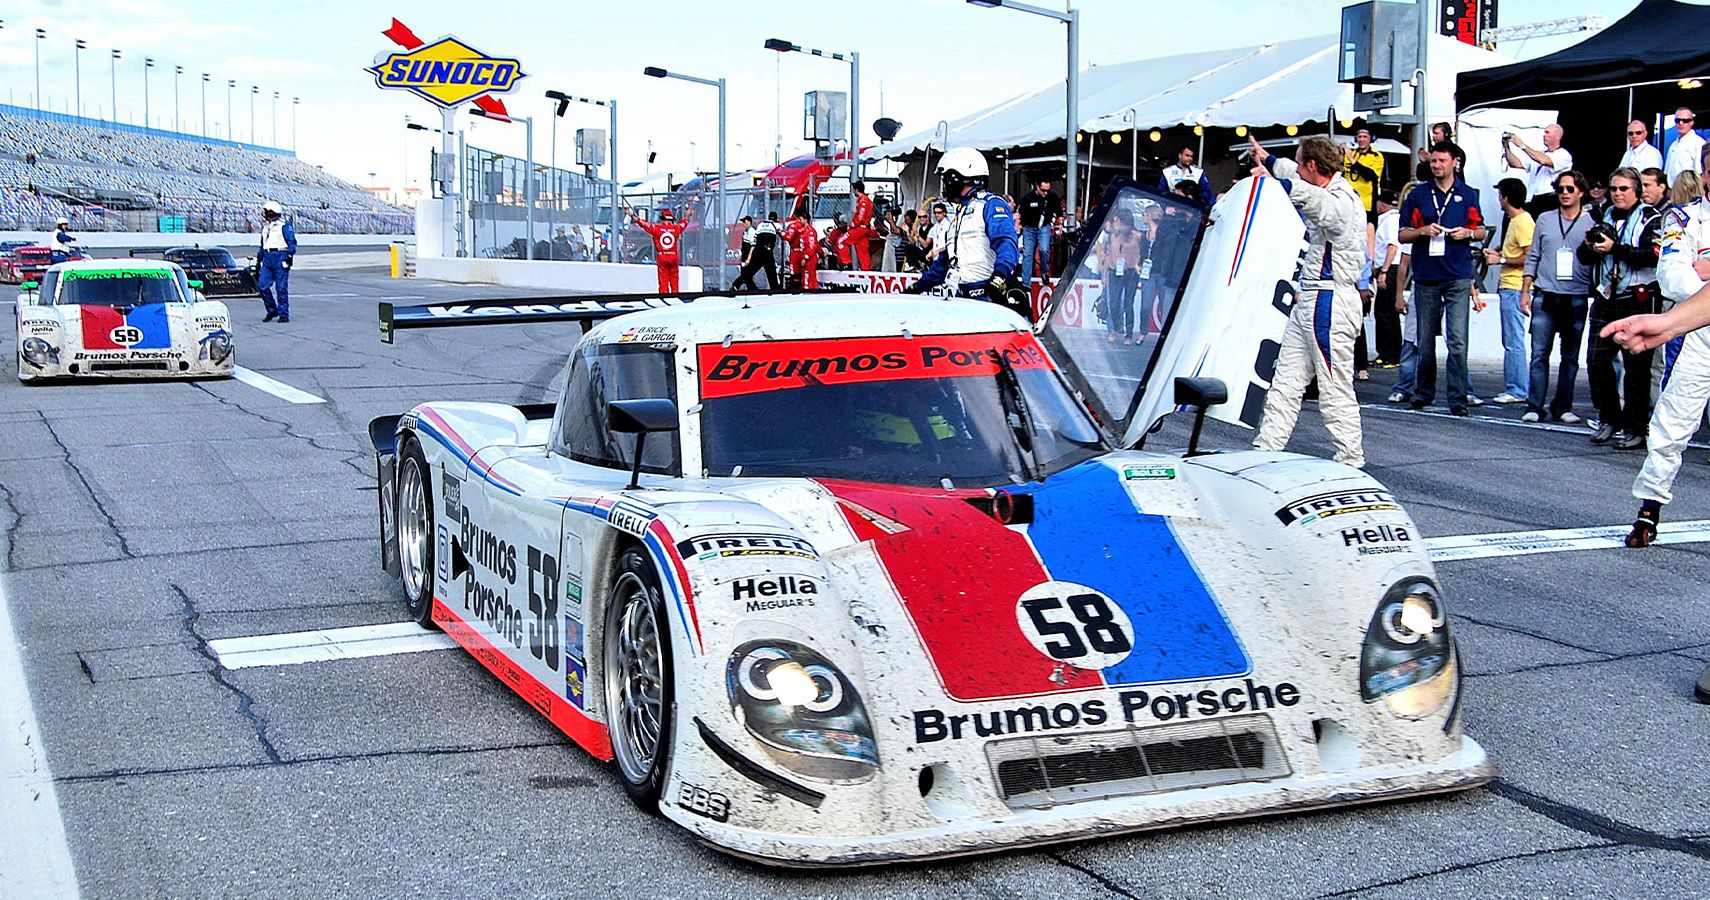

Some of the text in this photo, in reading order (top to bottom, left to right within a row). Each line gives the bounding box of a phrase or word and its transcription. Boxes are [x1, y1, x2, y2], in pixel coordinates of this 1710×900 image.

[386, 58, 515, 87] SUNOCO
[74, 351, 183, 361] Brumos Porsche
[114, 329, 140, 343] 59
[641, 333, 677, 342] GARCIA
[704, 340, 1045, 382] Brumos Porsche
[461, 505, 517, 586] Brumos
[1341, 525, 1411, 547] Hella
[464, 563, 523, 650] Porsche
[527, 544, 560, 672] 58
[733, 576, 818, 601] Hella
[1020, 593, 1131, 659] 58
[913, 678, 1301, 744] Brumos Porsche
[677, 781, 731, 823] BBS
